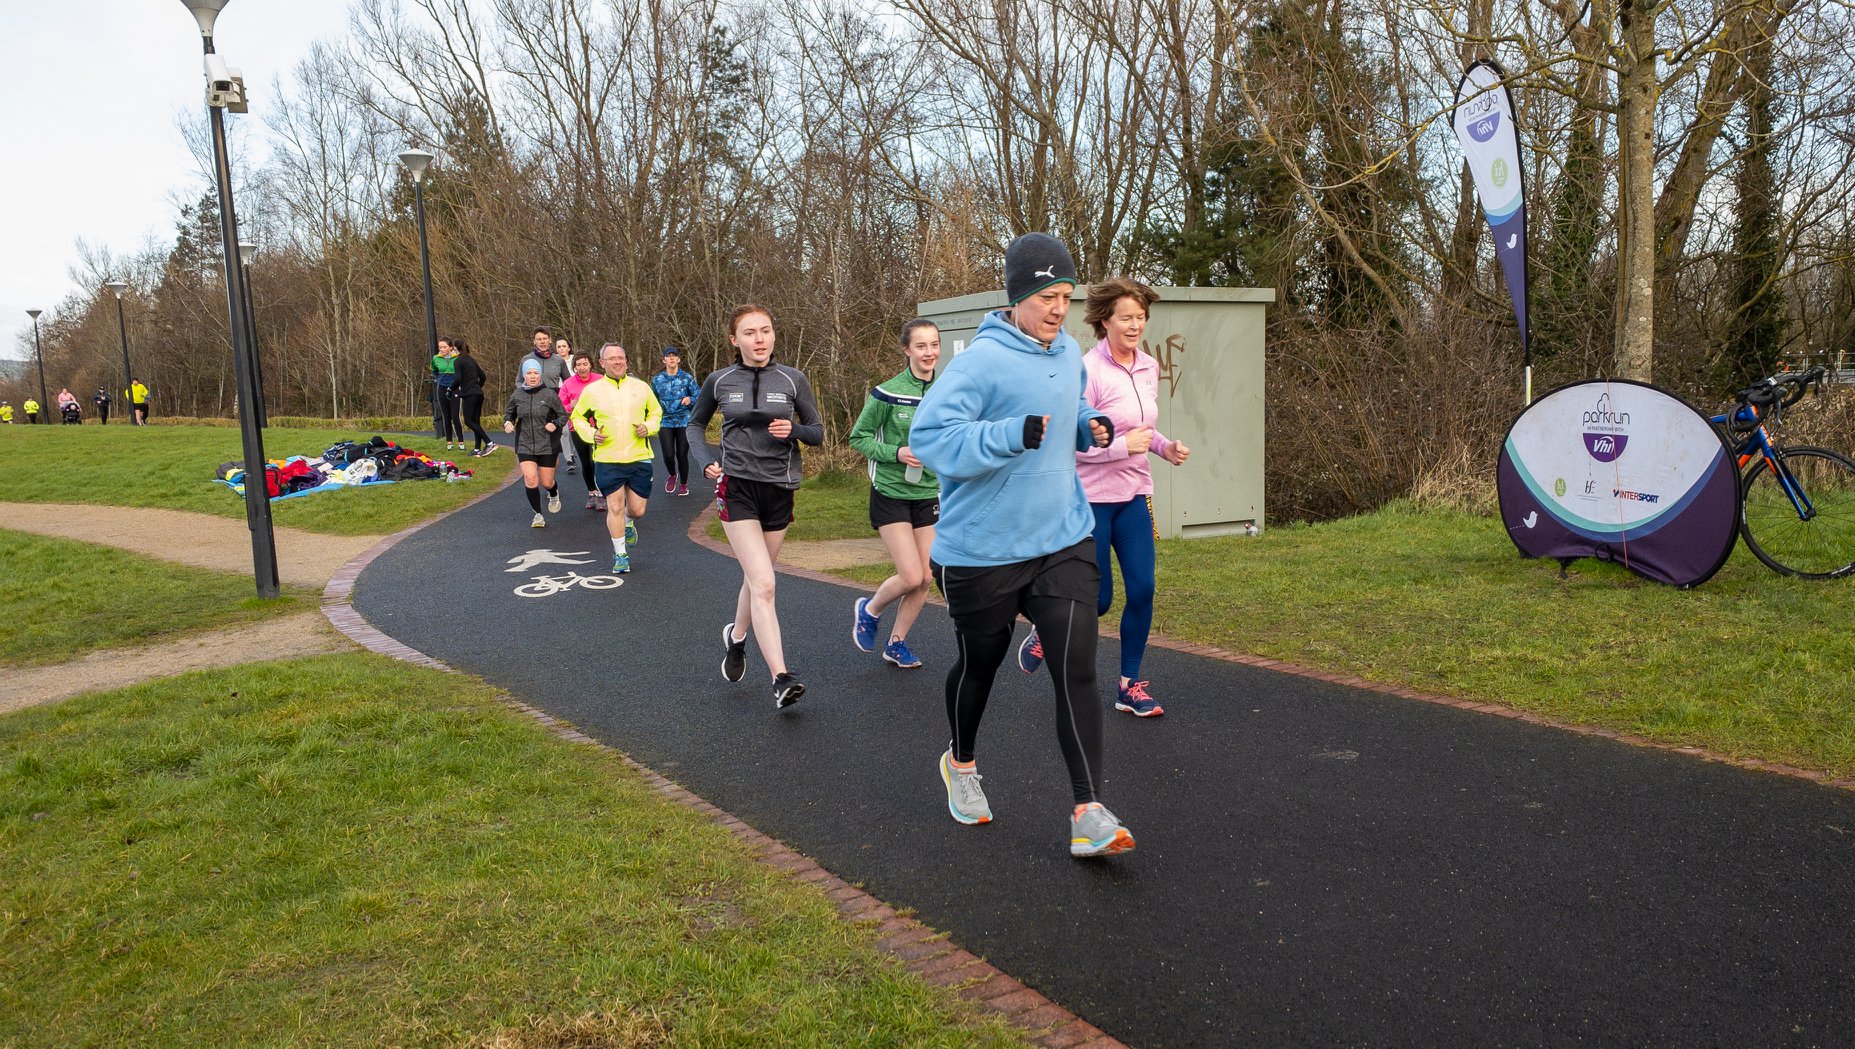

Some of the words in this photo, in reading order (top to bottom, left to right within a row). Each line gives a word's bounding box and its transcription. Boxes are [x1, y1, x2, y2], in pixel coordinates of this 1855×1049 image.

[1582, 402, 1630, 427] parkrun
[1593, 437, 1614, 454] Vhi
[1619, 490, 1660, 504] INTERSPORT
